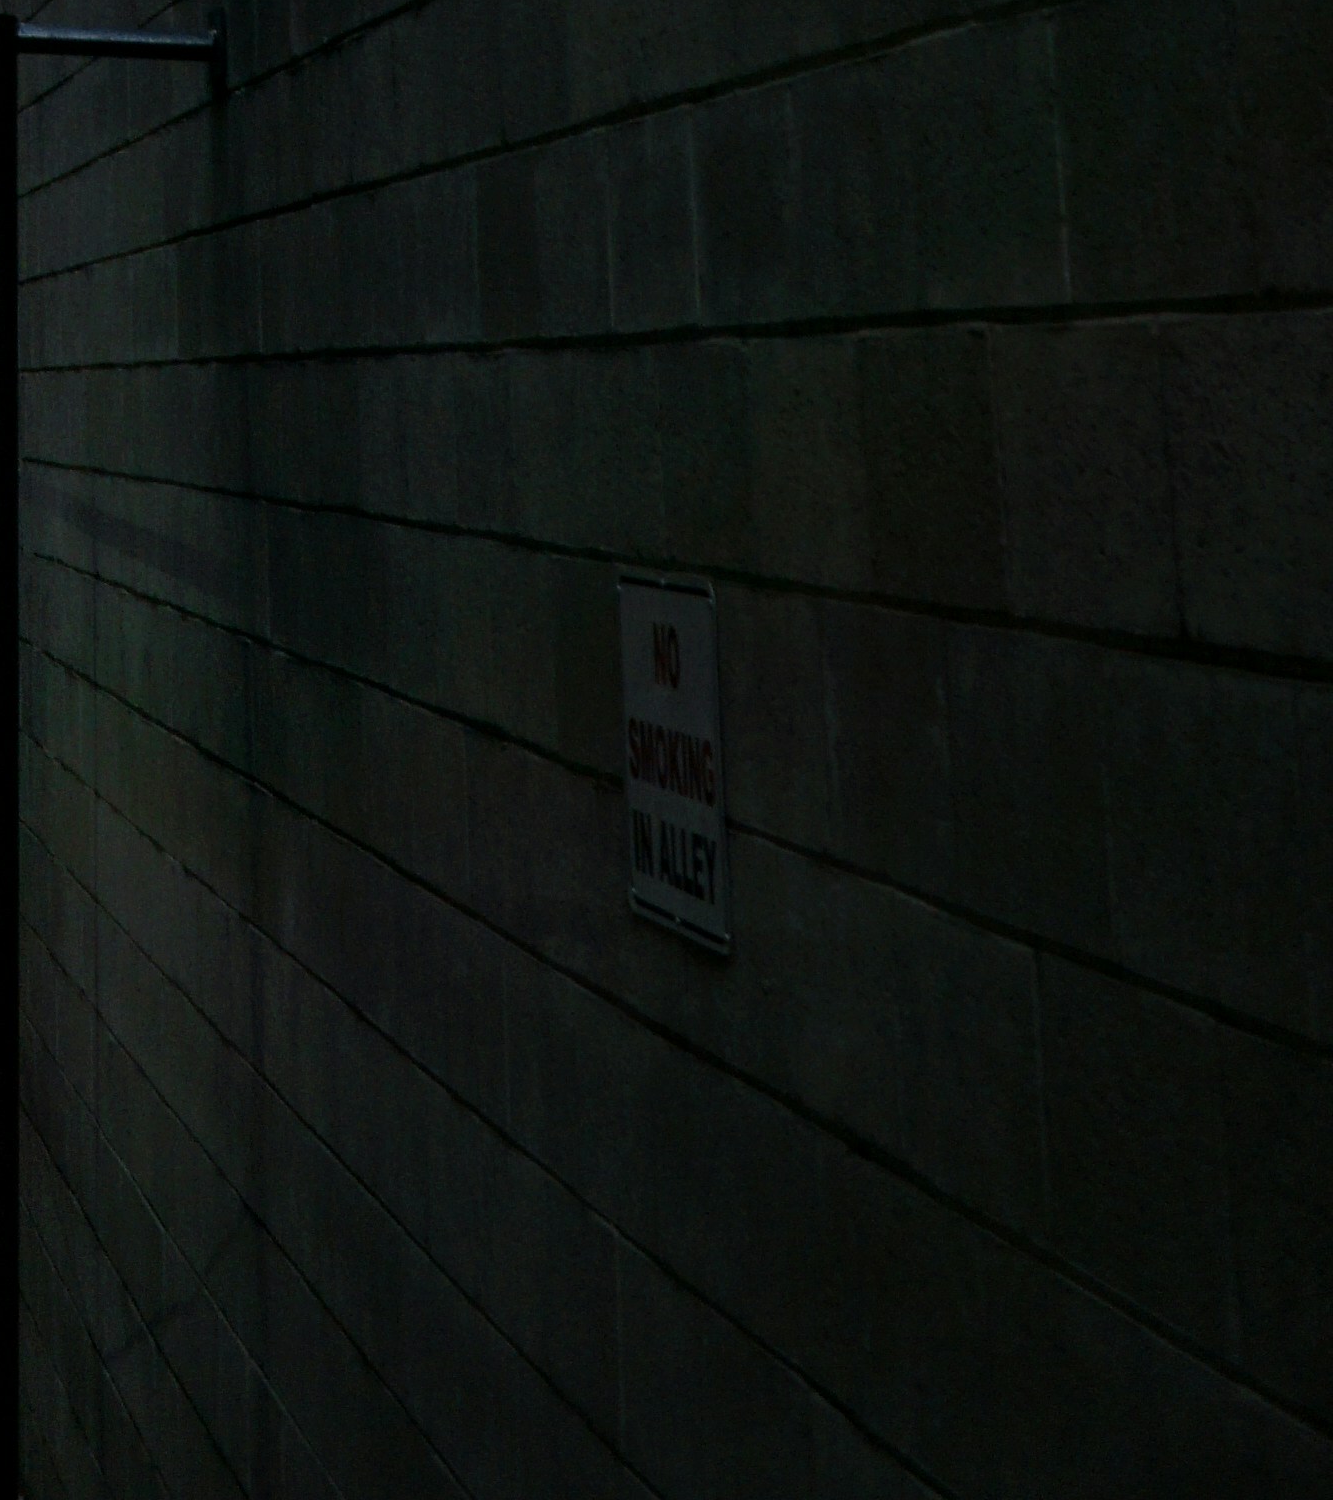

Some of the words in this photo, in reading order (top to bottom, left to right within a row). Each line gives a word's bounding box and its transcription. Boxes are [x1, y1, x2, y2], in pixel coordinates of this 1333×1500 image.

[652, 621, 682, 689] NO
[627, 716, 717, 809] SMOKING
[631, 807, 654, 878] IN
[659, 818, 718, 905] ALLEY
